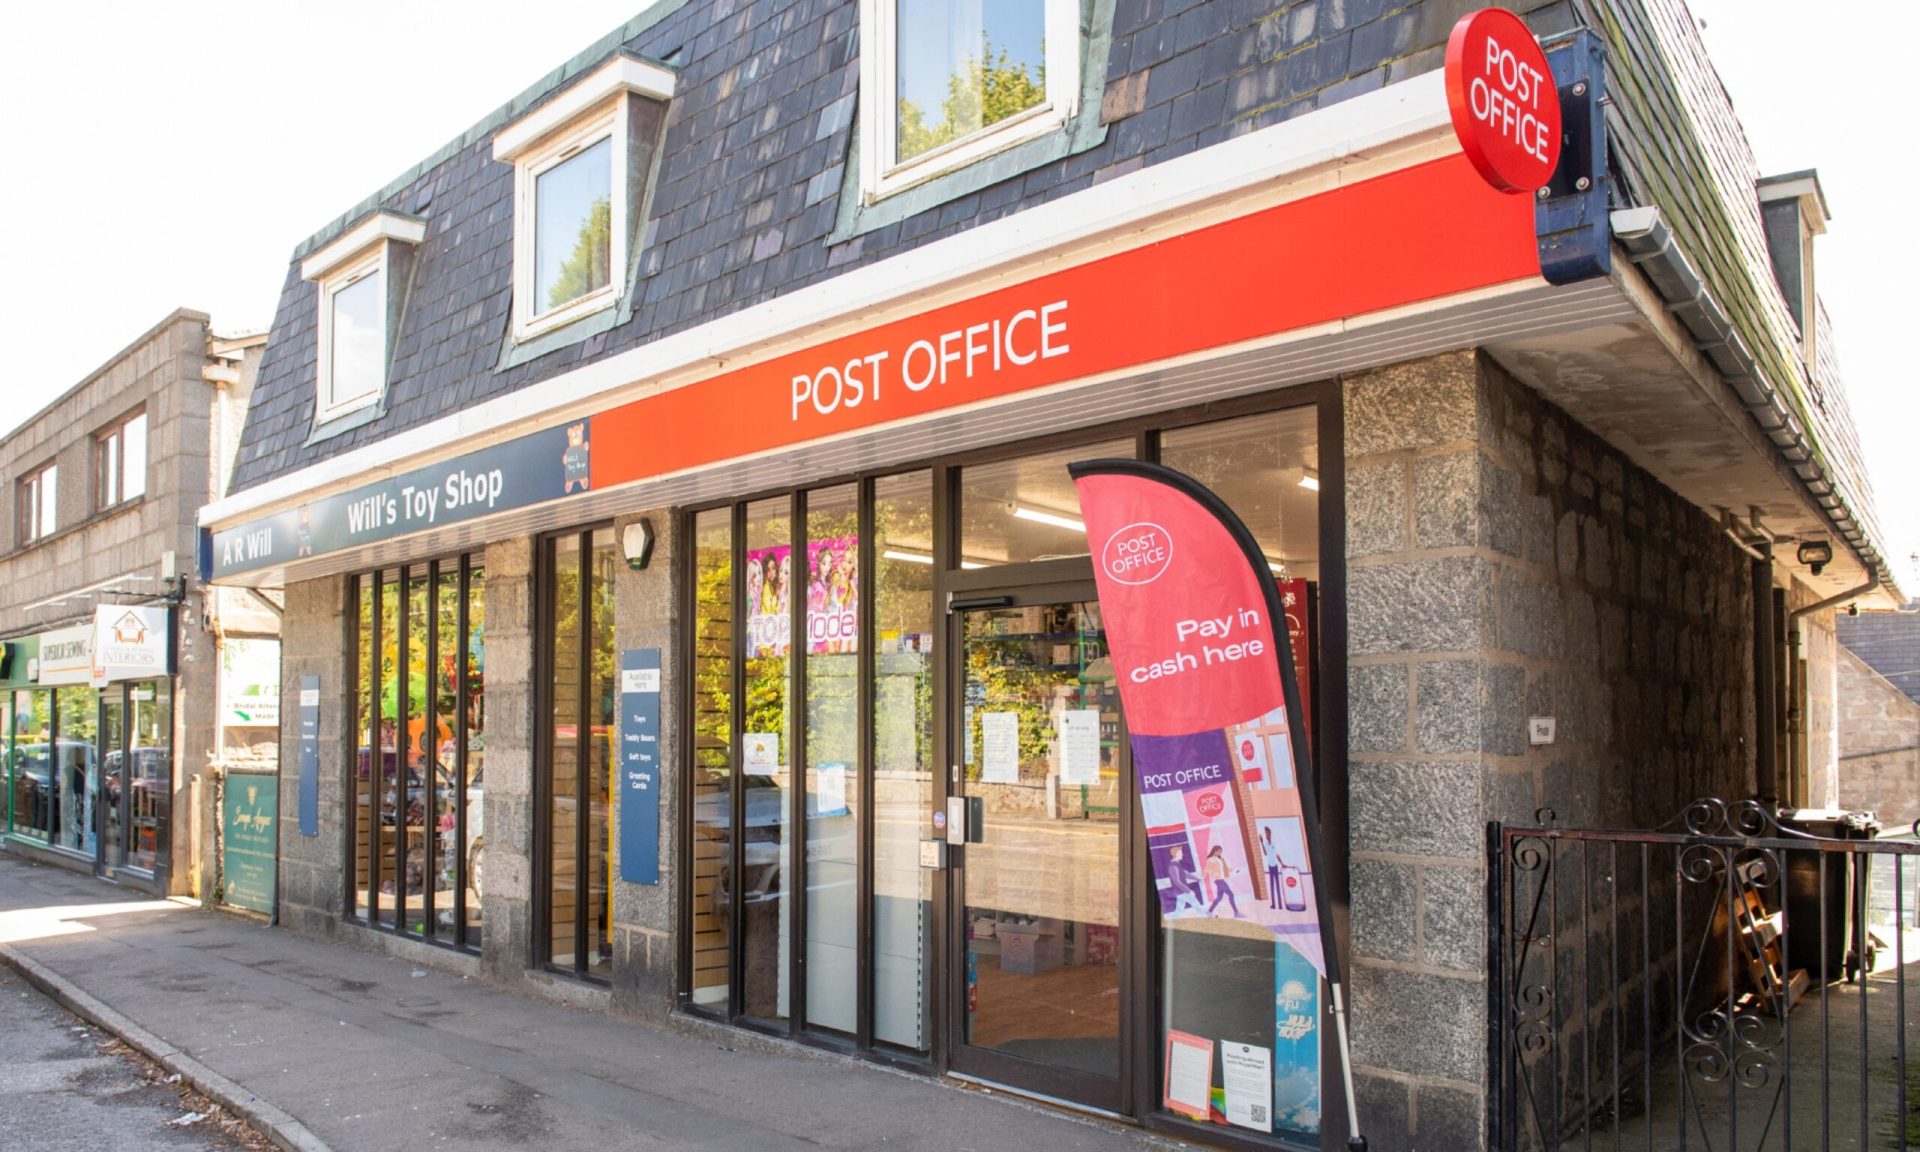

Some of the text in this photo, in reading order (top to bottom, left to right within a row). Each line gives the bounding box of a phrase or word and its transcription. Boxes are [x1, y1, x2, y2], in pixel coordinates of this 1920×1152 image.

[1486, 35, 1543, 109] POST
[1470, 77, 1549, 164] OFFICE
[792, 300, 1070, 421] POST OFFICE
[347, 468, 503, 534] Will's Toy Shop
[223, 541, 233, 566] A
[235, 537, 244, 563] R
[246, 527, 272, 560] Will
[1117, 533, 1156, 556] POST
[1112, 547, 1165, 574] OFFICE
[752, 614, 790, 643] TOP
[1176, 607, 1260, 643] Pay in
[1130, 639, 1264, 683] cash here
[633, 715, 646, 724] Toys
[625, 734, 640, 742] Teddy
[640, 753, 651, 762] toys
[629, 772, 650, 781] Greeting
[632, 781, 647, 790] Cards
[1143, 765, 1222, 789] POST OFFICE
[1199, 802, 1221, 813] OFFICE
[1201, 796, 1217, 804] POST
